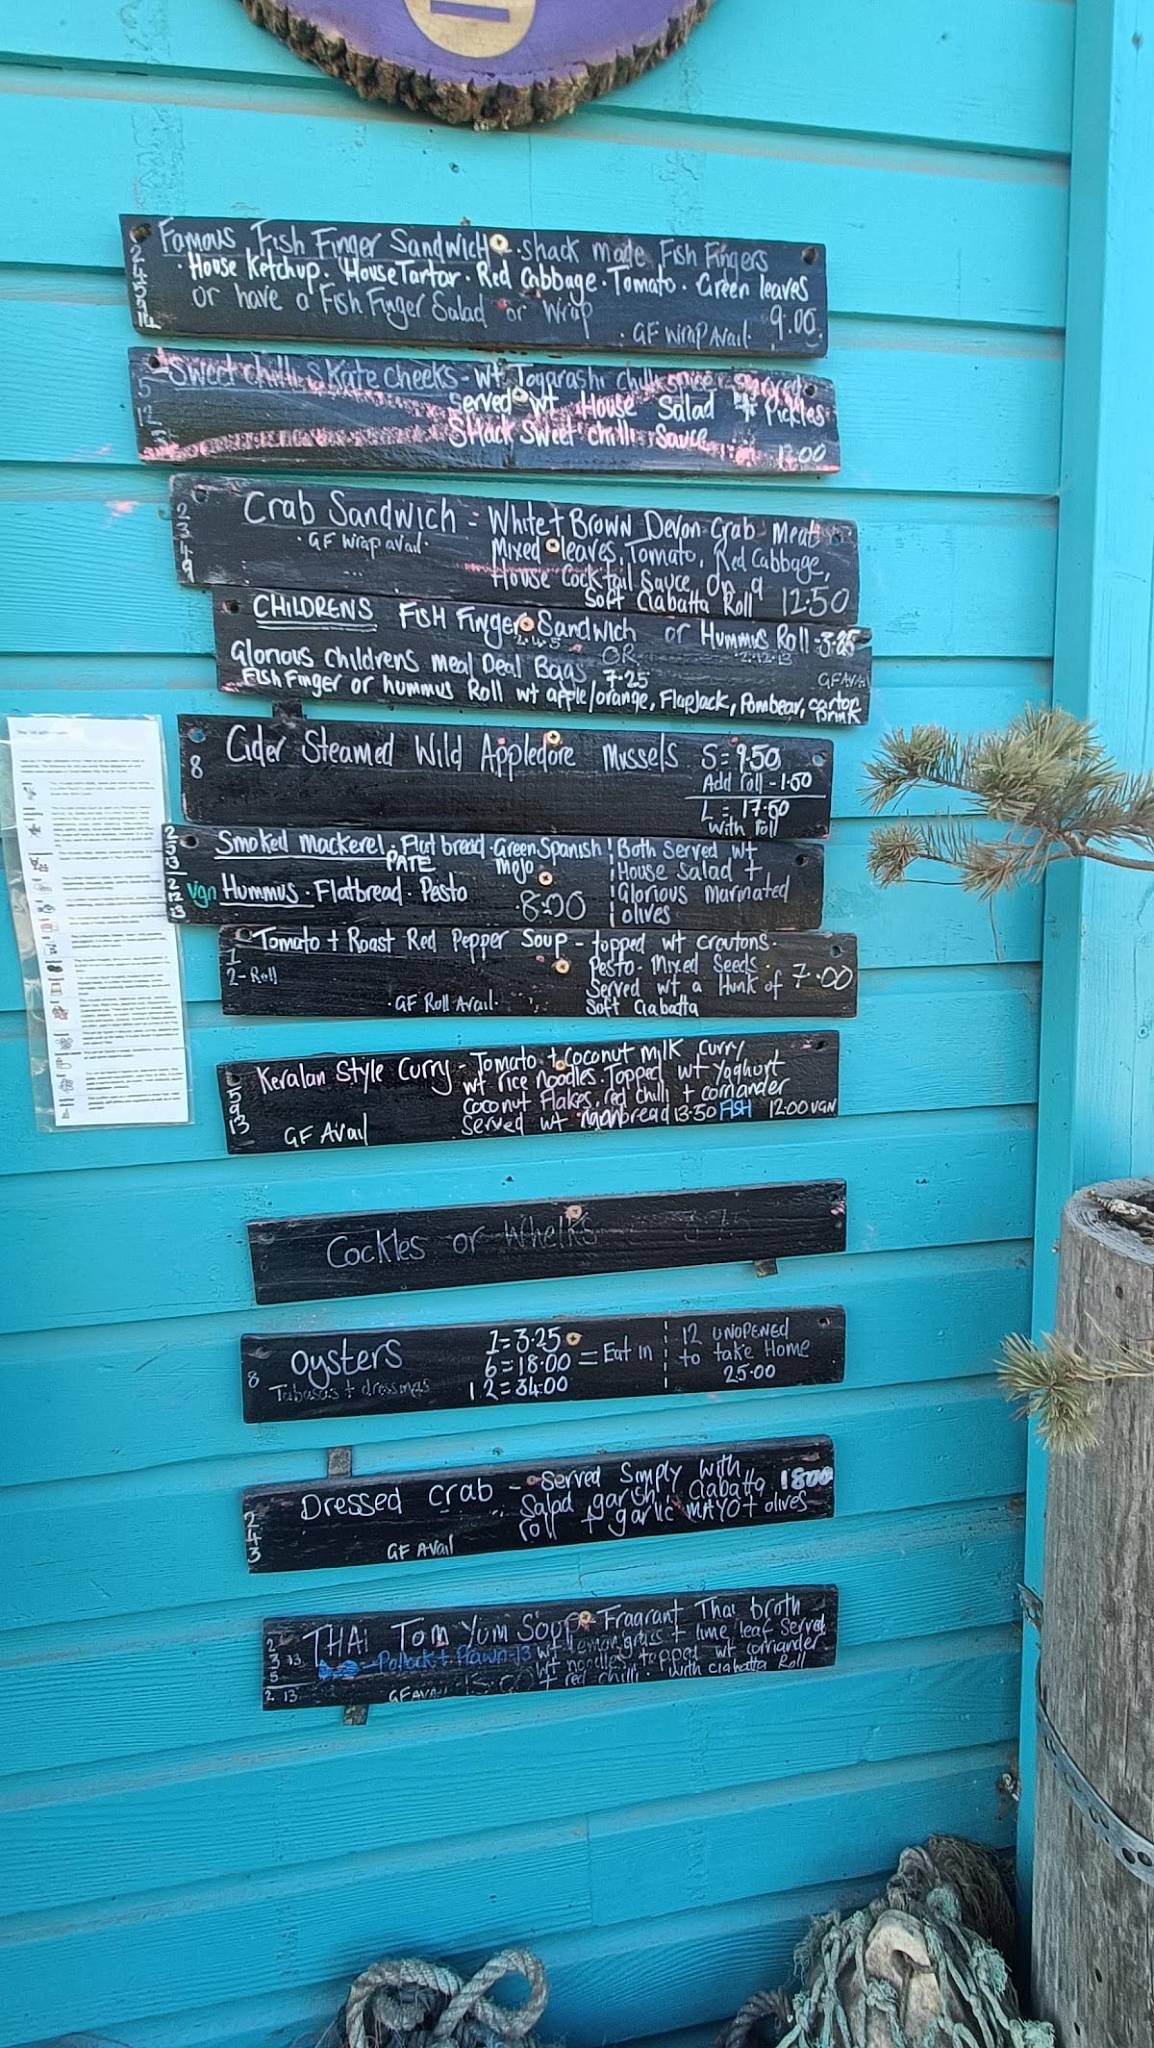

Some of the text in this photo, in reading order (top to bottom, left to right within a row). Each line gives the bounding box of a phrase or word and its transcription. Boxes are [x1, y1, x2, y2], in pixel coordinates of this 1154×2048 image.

[159, 217, 237, 256] Famous
[252, 220, 305, 258] Fish
[312, 227, 382, 260] Finger
[592, 238, 646, 267] made
[659, 239, 697, 269] Fish
[705, 244, 767, 277] Fingers
[189, 251, 237, 280] House
[476, 260, 513, 289] Red
[696, 270, 750, 299] Green
[759, 275, 809, 302] leaves
[192, 282, 593, 339] or have Fish Finger Salad Wrap
[632, 321, 660, 345] GF
[449, 388, 512, 418] Served
[577, 389, 638, 420] House
[657, 391, 716, 422] Salad
[244, 490, 315, 526] Crab
[329, 489, 456, 534] Sandwich
[489, 500, 546, 537] White
[308, 531, 333, 552] GF
[492, 537, 541, 567] Mixed
[492, 563, 551, 592] House
[562, 562, 634, 593] Cocktail
[724, 588, 764, 618] Roll
[780, 587, 850, 618] 12.50
[252, 594, 376, 622] CHILDRENS
[536, 610, 638, 650] Sandwich
[664, 622, 691, 647] or
[701, 621, 770, 658] Hummus
[777, 623, 810, 655] Roll
[285, 669, 342, 698] Finger
[350, 672, 375, 698] or
[467, 676, 503, 703] Roll
[534, 654, 588, 686] Bags
[189, 753, 204, 781] 8
[225, 723, 288, 767] Cider
[302, 726, 394, 768] Steamed
[414, 730, 463, 773] Wild
[480, 732, 577, 784] Appledore
[702, 772, 733, 795] Add
[216, 827, 291, 861] Smoked
[538, 838, 604, 867] Spanish
[618, 839, 657, 867] Both
[664, 841, 720, 864] Served
[221, 872, 690, 909] Hummus Flatbread Pesto Glorious
[386, 857, 734, 891] PATE House Salad
[621, 902, 673, 928] olives
[252, 926, 321, 955] Tomato
[347, 925, 396, 955] Roast
[407, 927, 438, 954] Red
[451, 927, 511, 965] Pepper
[586, 972, 642, 999] Served
[718, 968, 757, 997] Hunk
[396, 992, 451, 1014] GF Roll
[585, 997, 621, 1017] Soft
[256, 1062, 327, 1096] Keralan
[335, 1057, 385, 1095] Style
[397, 1055, 453, 1097] Curry
[470, 1044, 539, 1078] Tomato
[283, 1124, 314, 1151] GF
[460, 1112, 526, 1139] Served
[327, 1225, 481, 1269] Cockles or
[291, 1337, 405, 1390] Oysters
[602, 1333, 635, 1366] Eat
[638, 1343, 653, 1364] in
[716, 1343, 755, 1367] take
[300, 1487, 403, 1523] Dressed
[428, 1477, 494, 1510] Crab
[540, 1466, 602, 1491] Served
[519, 1485, 575, 1519] Salad
[387, 1542, 411, 1561] GF
